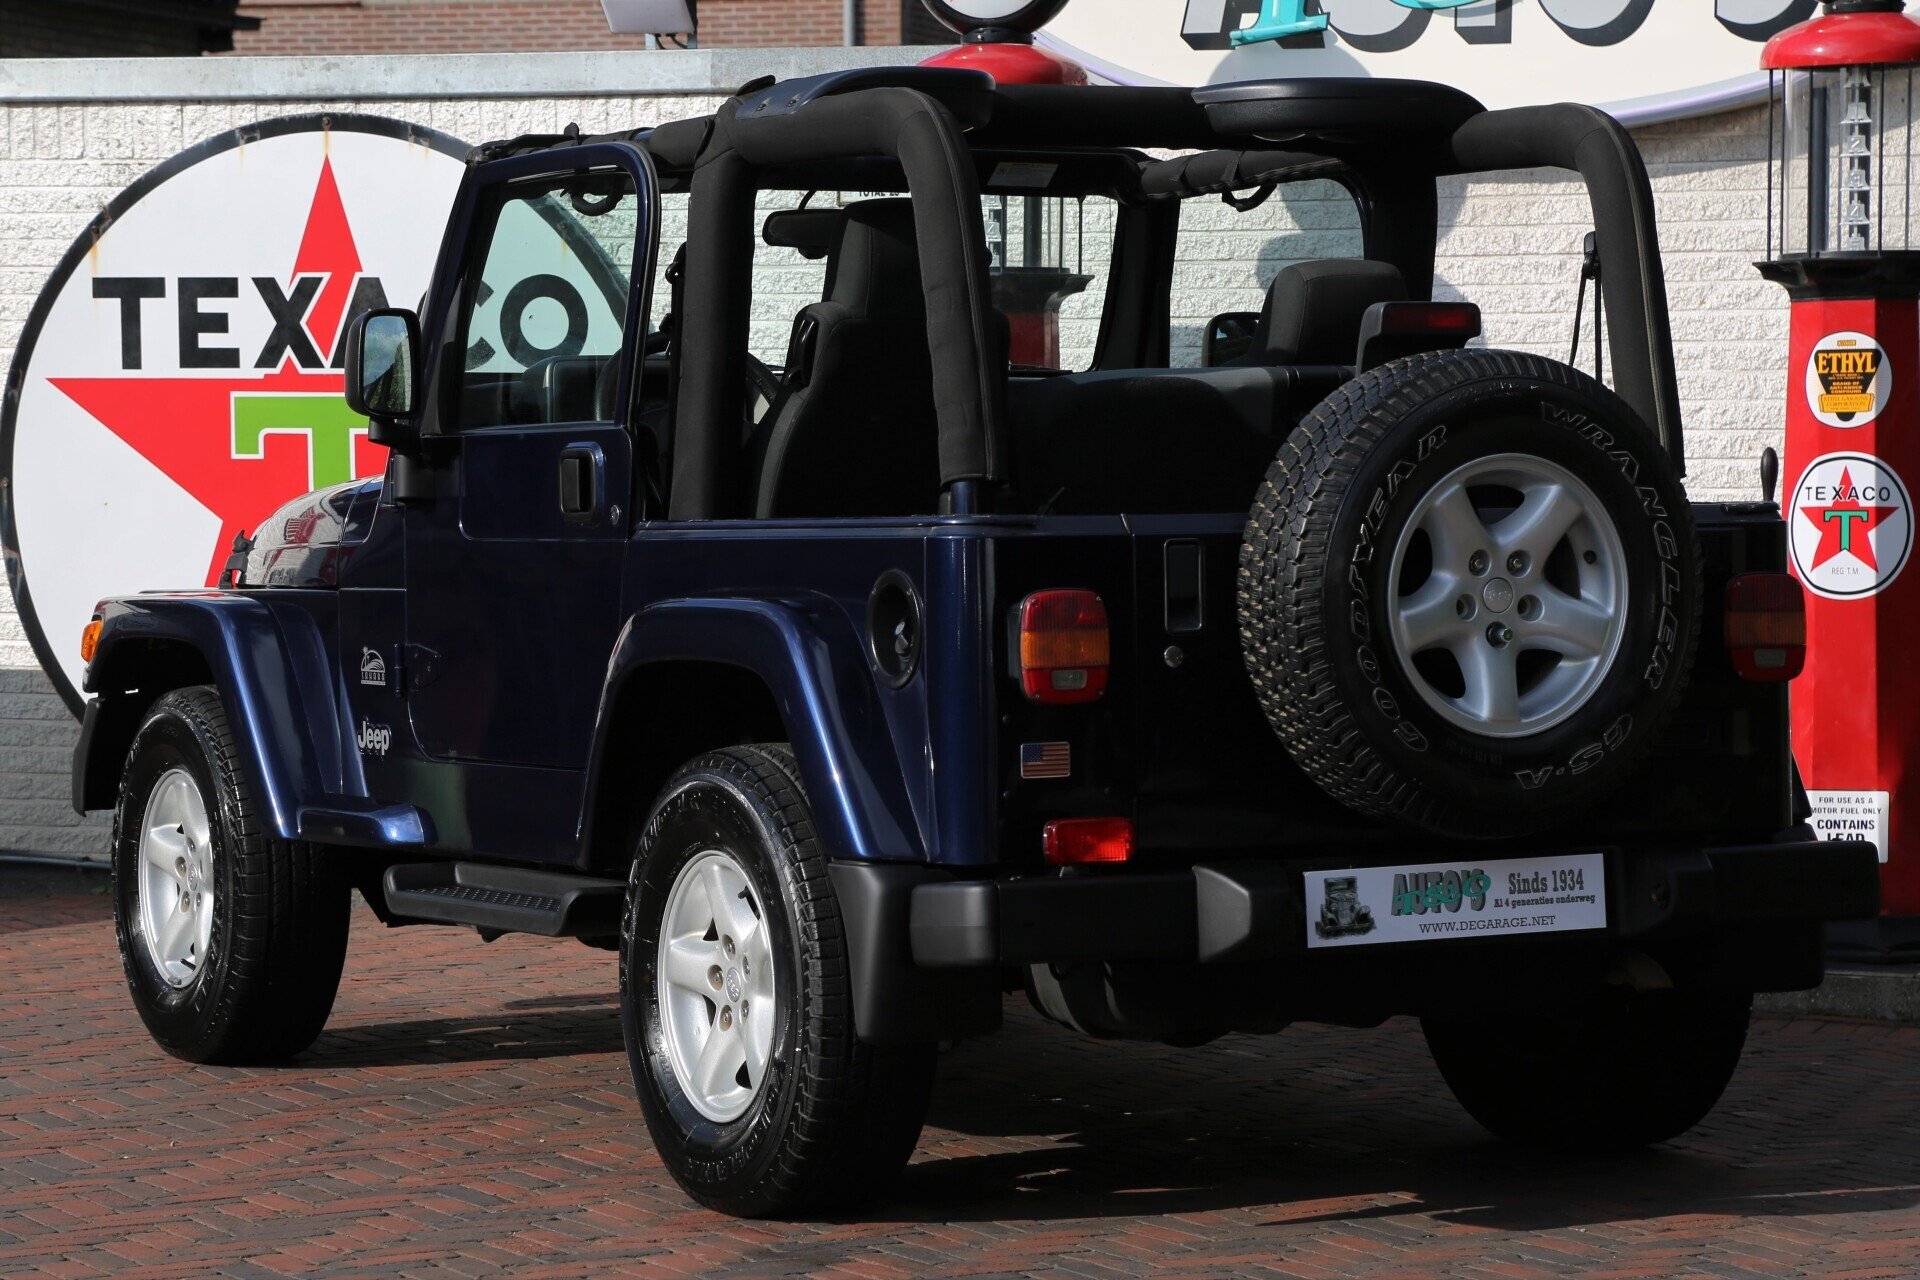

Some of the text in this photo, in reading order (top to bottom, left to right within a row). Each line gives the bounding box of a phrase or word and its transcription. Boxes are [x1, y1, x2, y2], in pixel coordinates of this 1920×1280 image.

[1818, 351, 1876, 374] ETHYL
[1805, 486, 1891, 502] TEXACO
[1824, 510, 1868, 551] T
[1540, 401, 1682, 689] WRANGLER
[1349, 424, 1447, 752] GOODYEAR
[358, 721, 390, 755] Jeep
[1817, 820, 1875, 830] CONTAINS
[1508, 868, 1585, 895] Sinds 1934
[1504, 897, 1510, 907] 4
[1512, 894, 1554, 909] generaties
[1556, 894, 1596, 904] onderweg
[1419, 915, 1556, 934] WWW.DEGARAGE.NET
